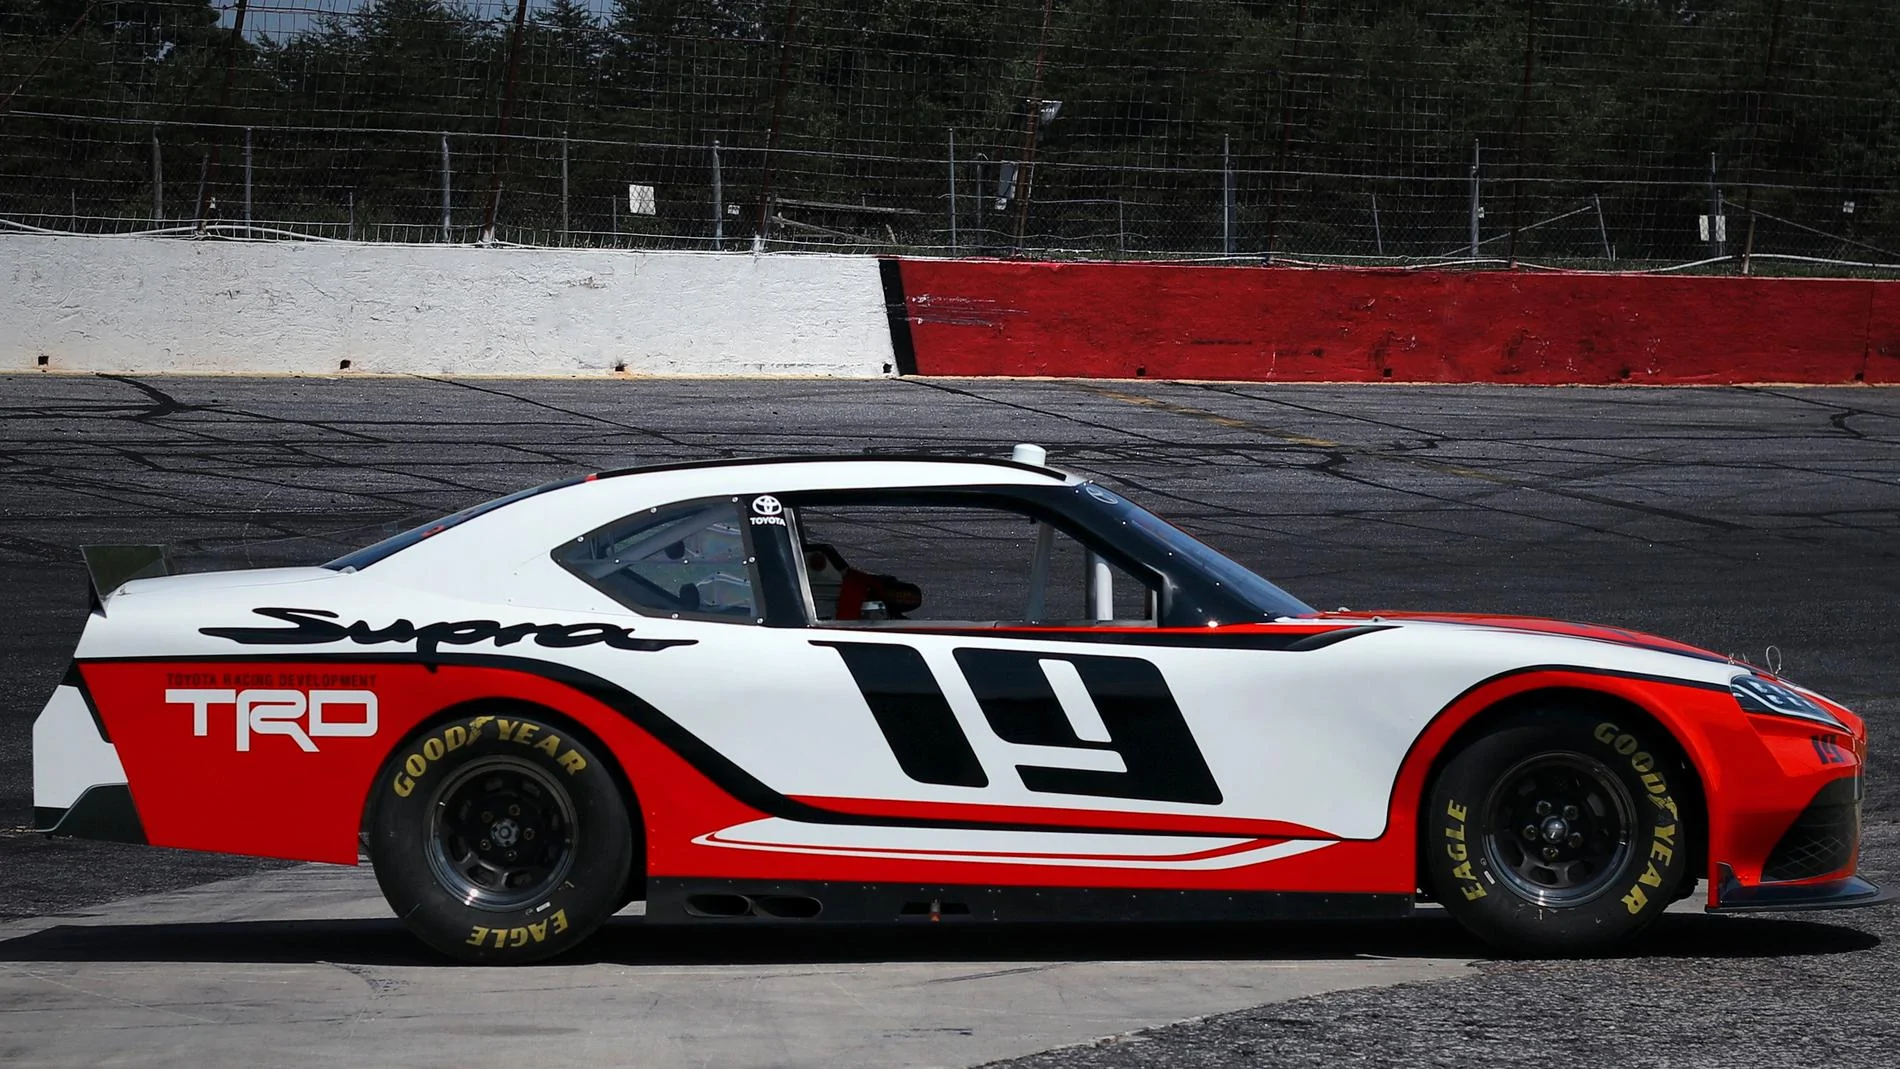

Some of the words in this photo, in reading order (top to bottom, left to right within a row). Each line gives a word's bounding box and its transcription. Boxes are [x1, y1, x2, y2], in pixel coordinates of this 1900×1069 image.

[749, 516, 786, 527] TOYOTA
[199, 606, 699, 672] Supra
[166, 673, 217, 686] TOYOTA
[223, 673, 273, 686] RACING
[279, 673, 377, 687] DEVELOPMENT
[165, 689, 378, 752] TRD
[808, 638, 1223, 805] 19
[1811, 735, 1844, 765] 19
[1445, 799, 1487, 900] EAGLE
[466, 908, 569, 948] EAGLE
